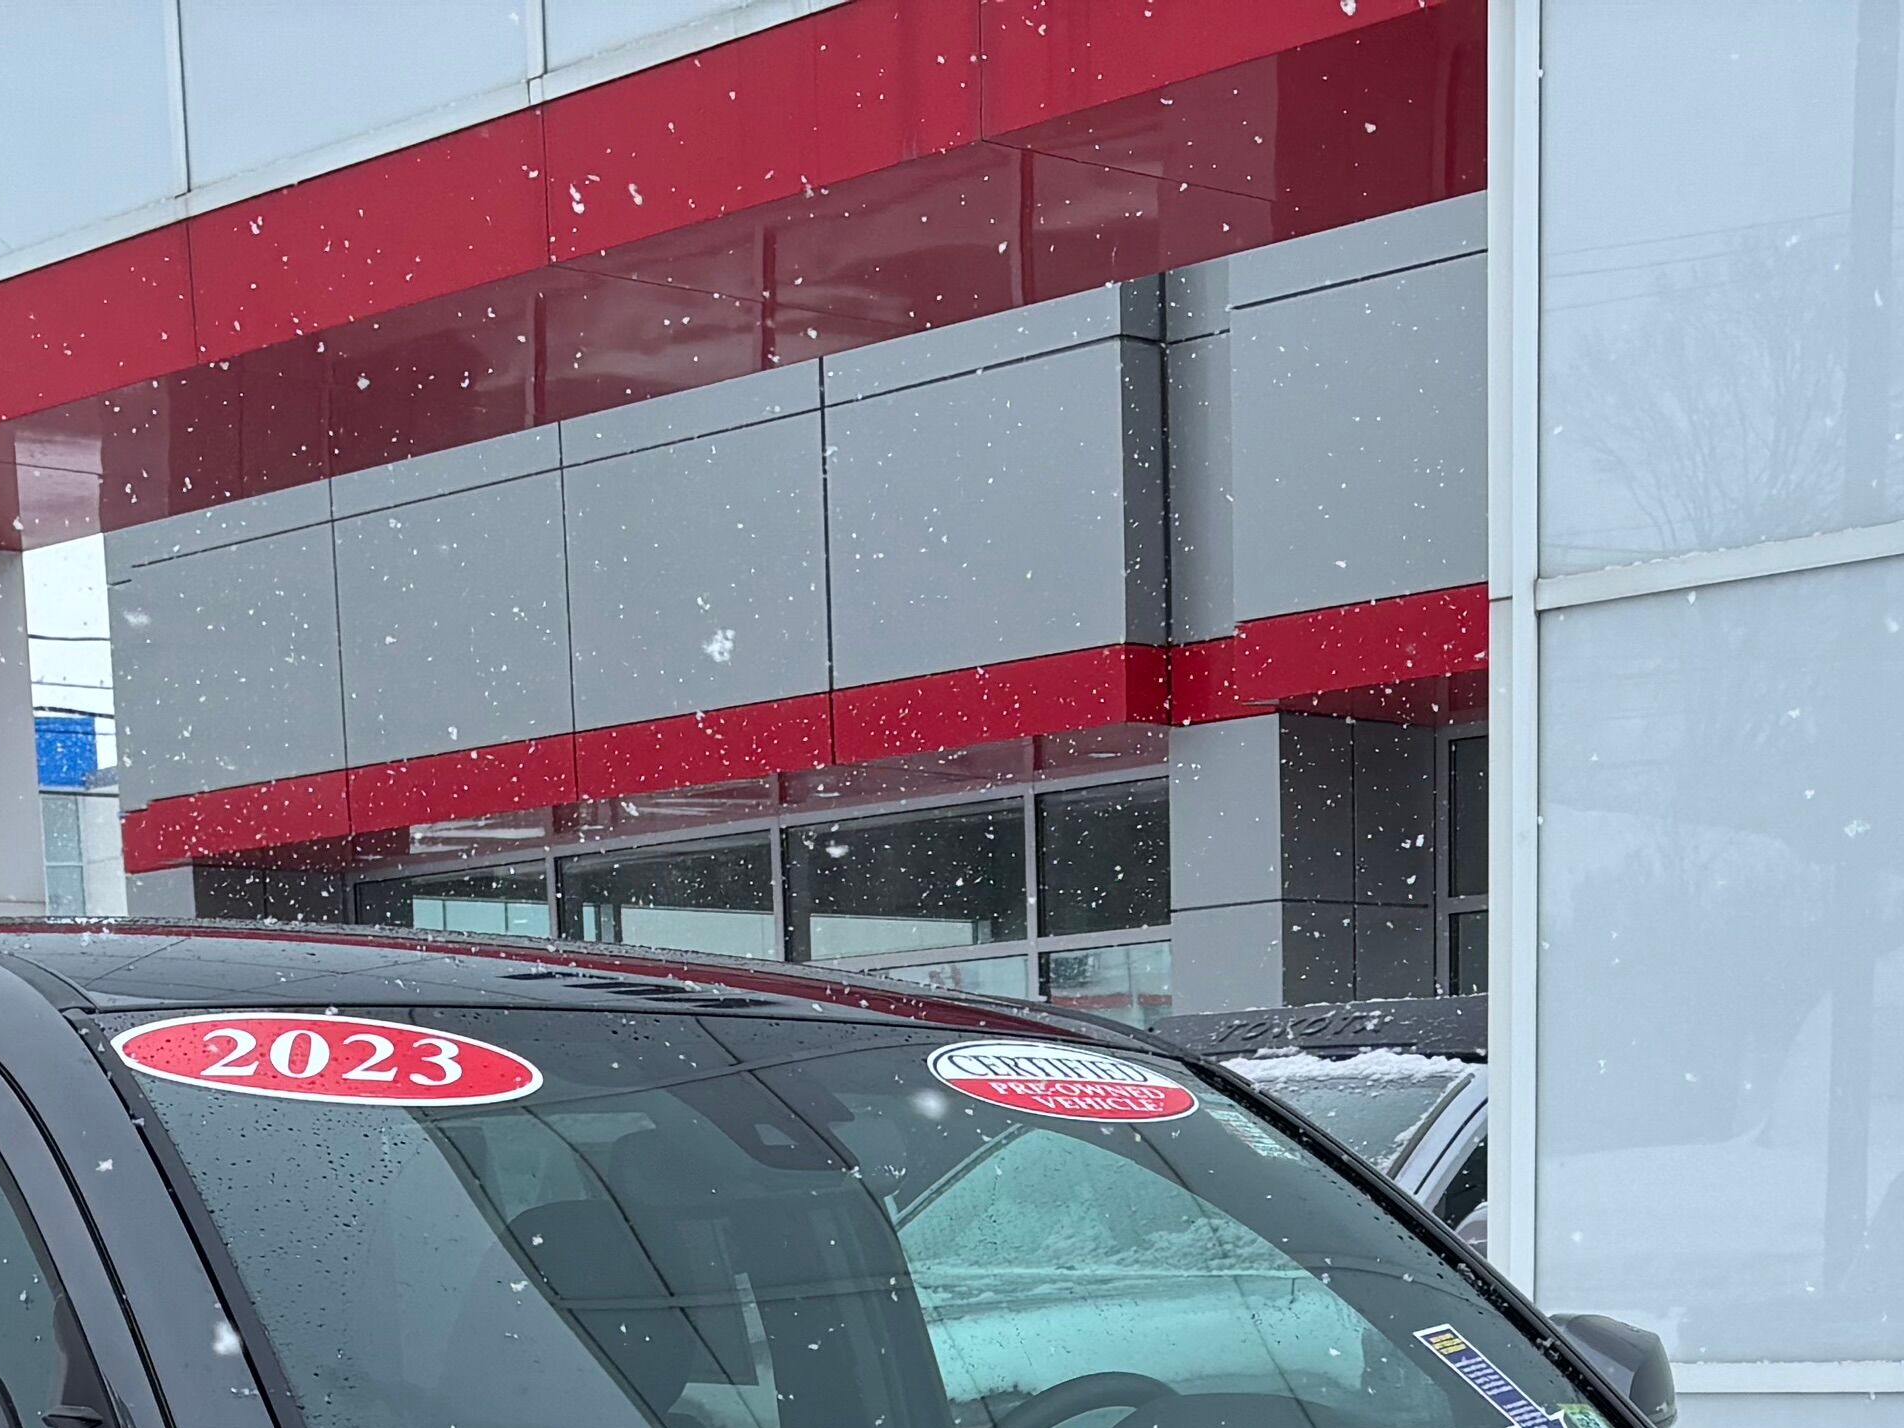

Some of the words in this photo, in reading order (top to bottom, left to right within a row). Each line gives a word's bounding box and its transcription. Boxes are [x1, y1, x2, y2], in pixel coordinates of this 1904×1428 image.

[199, 1027, 463, 1087] 2023
[947, 1053, 1149, 1083] CERTIFIED
[989, 1081, 1166, 1100] PRE-OWNED
[1031, 1095, 1163, 1113] VEHICLE
